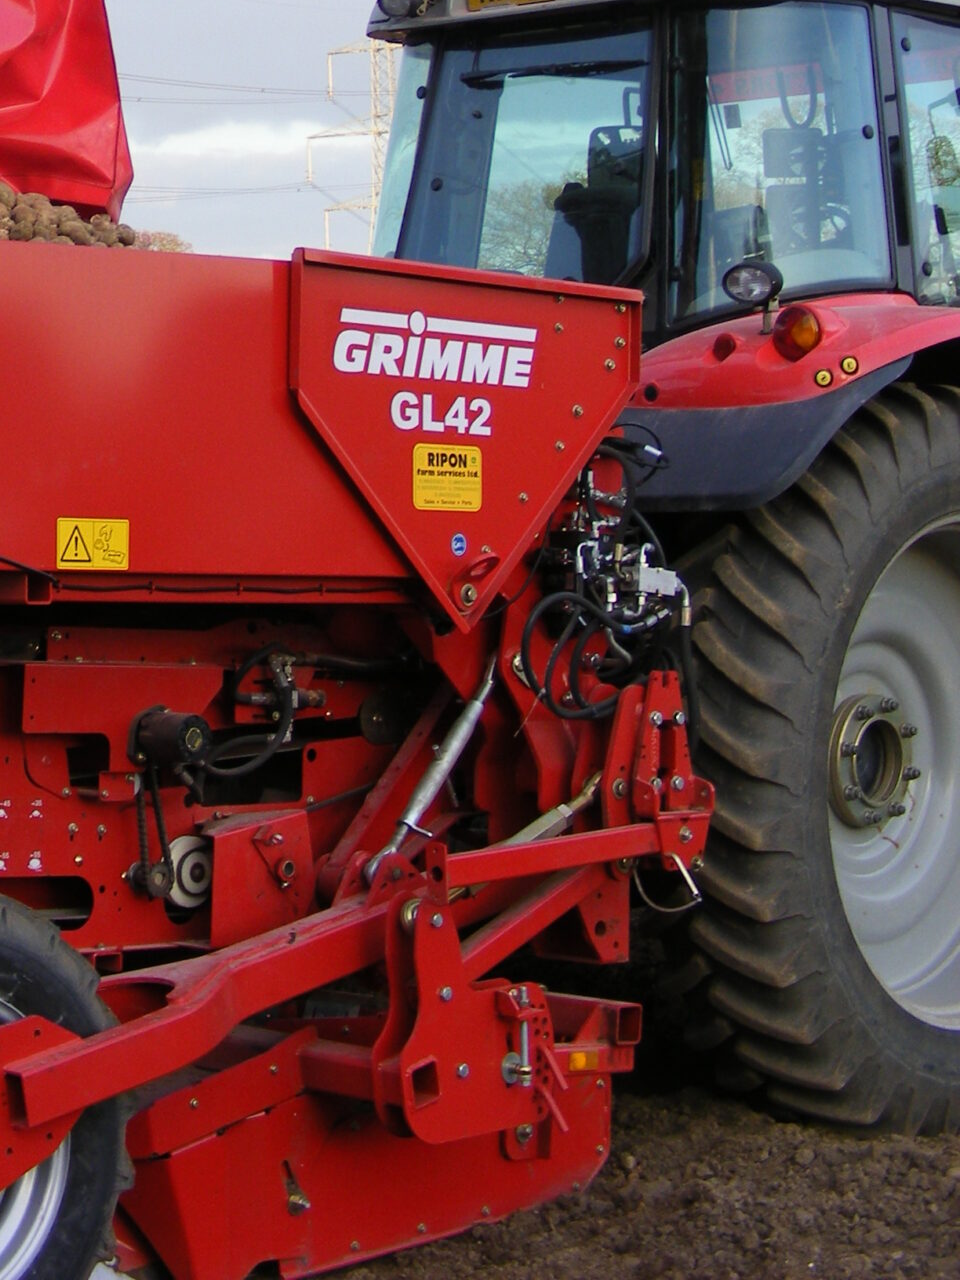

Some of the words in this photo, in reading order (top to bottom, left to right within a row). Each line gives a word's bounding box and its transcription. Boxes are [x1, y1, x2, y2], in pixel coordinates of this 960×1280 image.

[332, 310, 535, 388] GRIMME
[390, 391, 492, 436] GL42
[416, 468, 435, 476] farm
[436, 469, 466, 477] services
[427, 452, 468, 468] RIPON
